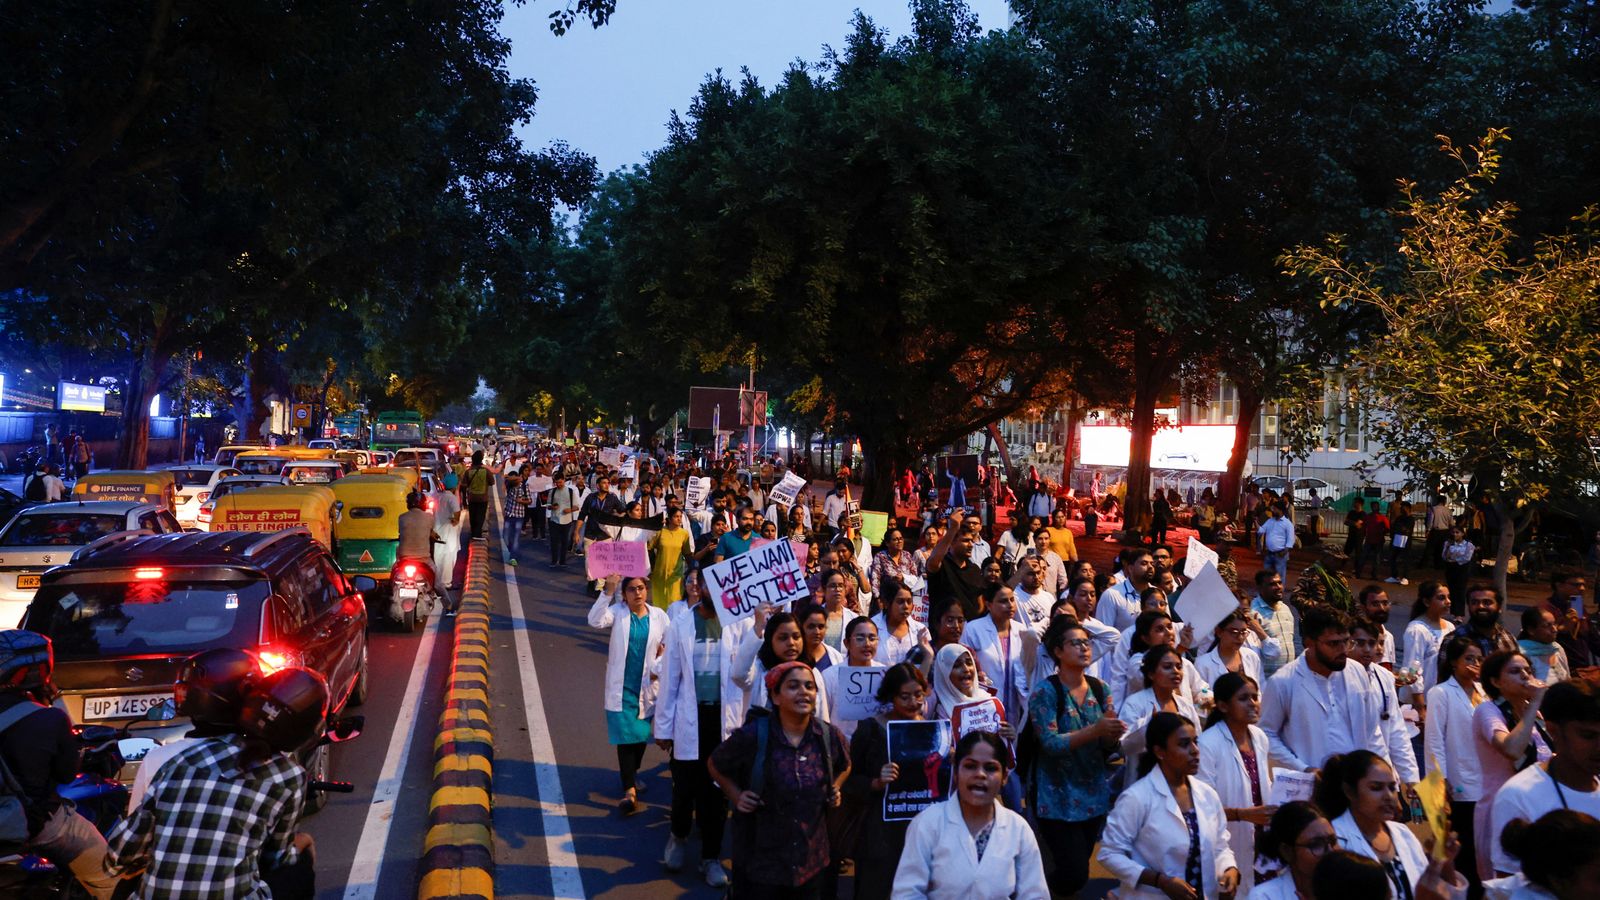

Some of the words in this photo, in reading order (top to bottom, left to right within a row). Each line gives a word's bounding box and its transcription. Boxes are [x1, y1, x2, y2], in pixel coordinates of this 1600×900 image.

[771, 491, 792, 504] AIPWA
[229, 512, 253, 520] लोन
[273, 512, 297, 520] लोन
[711, 555, 752, 588] WE
[749, 537, 795, 574] WANT
[725, 569, 807, 617] JUSTICE
[847, 669, 885, 695] ST
